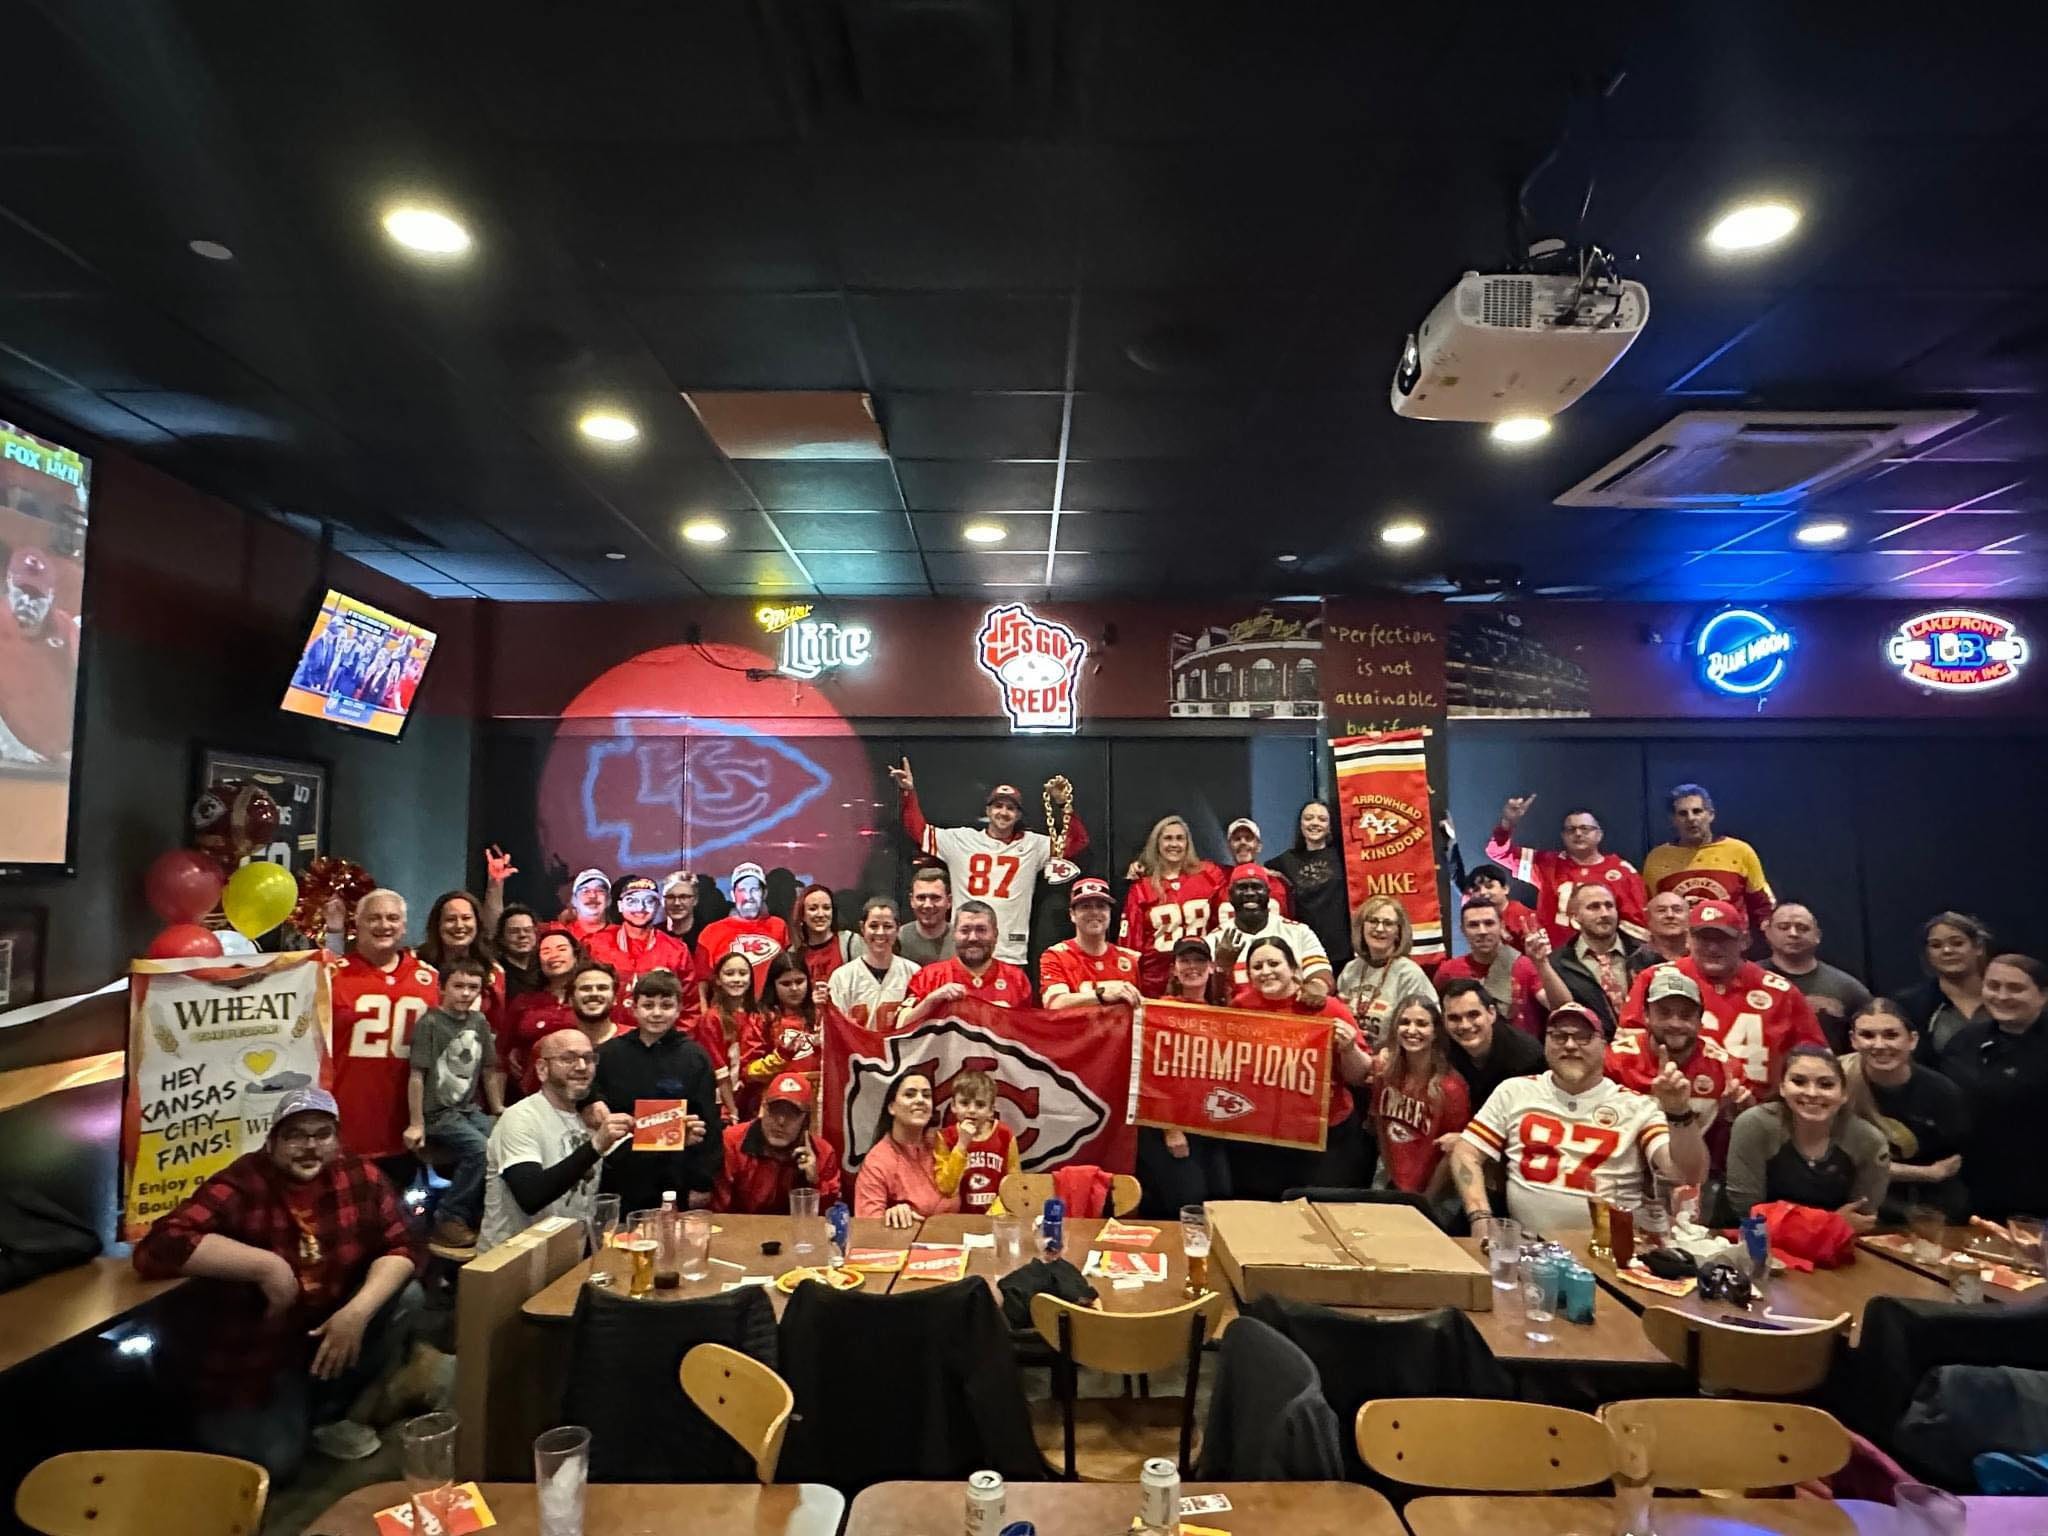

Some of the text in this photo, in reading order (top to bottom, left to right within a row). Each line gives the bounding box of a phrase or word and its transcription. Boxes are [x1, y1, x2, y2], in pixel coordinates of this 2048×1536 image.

[4, 440, 41, 471] FOX
[1036, 627, 1068, 661] GO
[1910, 616, 2005, 638] LAKEFRONT
[778, 620, 872, 679] Lite
[1357, 657, 1413, 677] is not
[1010, 680, 1068, 714] RED!
[1346, 719, 1376, 736] but
[1351, 794, 1423, 821] ARROWHEAD
[1358, 811, 1400, 836] AK
[1360, 826, 1426, 862] KINGDOM
[967, 852, 1020, 899] 87
[1366, 871, 1419, 896] MKE
[1150, 898, 1210, 952] 88
[172, 991, 297, 1031] WHEAT
[348, 994, 428, 1059] 20
[1166, 1015, 1220, 1036] SUPER
[161, 1063, 207, 1092] HEY
[1152, 1029, 1319, 1096] CHAMPIONS
[141, 1080, 238, 1124] KANSAS
[163, 1109, 219, 1142] CITY
[156, 1129, 232, 1172] FANS!
[1519, 1111, 1620, 1192] 87
[138, 1177, 188, 1196] Enjoy
